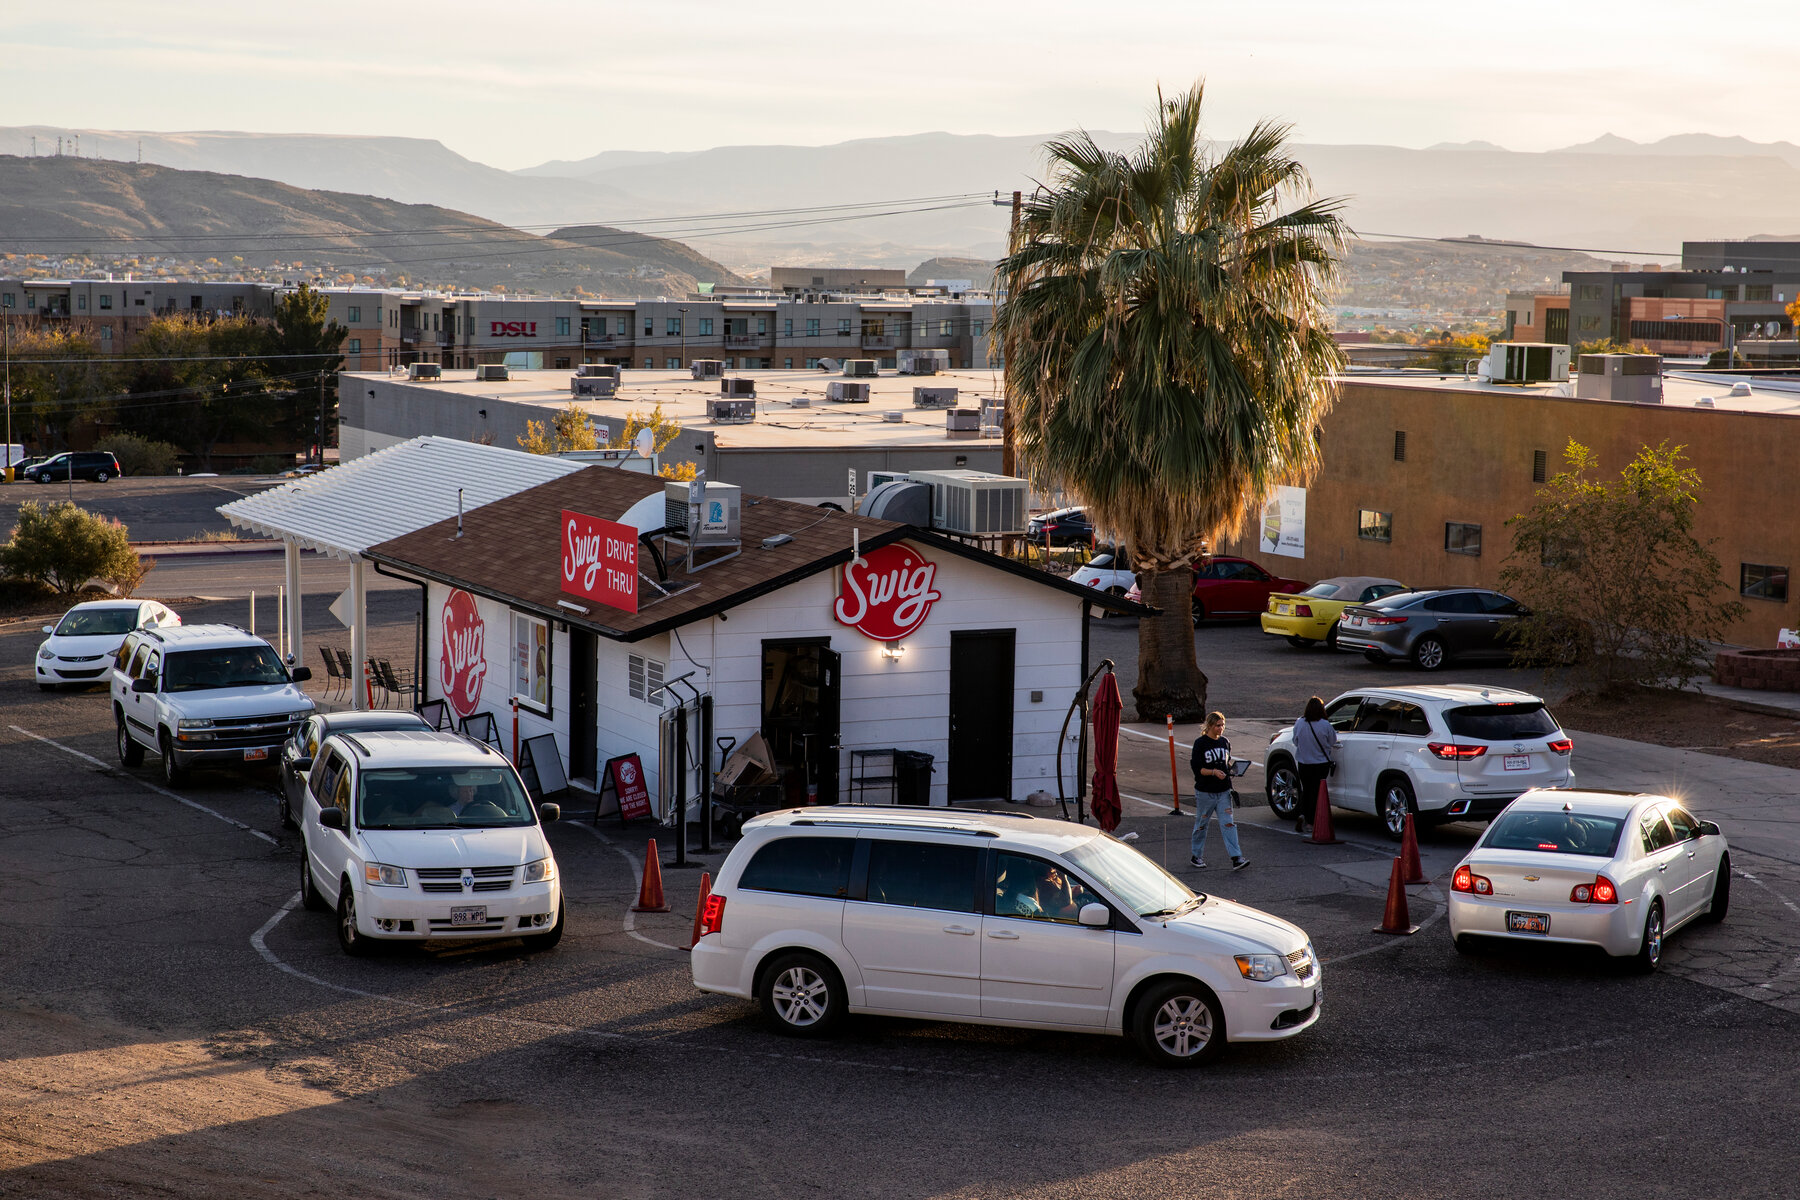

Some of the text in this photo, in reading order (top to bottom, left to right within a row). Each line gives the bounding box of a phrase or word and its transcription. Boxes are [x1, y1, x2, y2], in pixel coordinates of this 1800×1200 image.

[490, 321, 537, 337] DSU
[564, 519, 602, 592] Swig
[606, 537, 634, 564] DRIVE
[606, 568, 633, 595] THRU
[835, 557, 940, 627] Swig
[441, 606, 486, 703] Swig
[453, 912, 467, 921] 898
